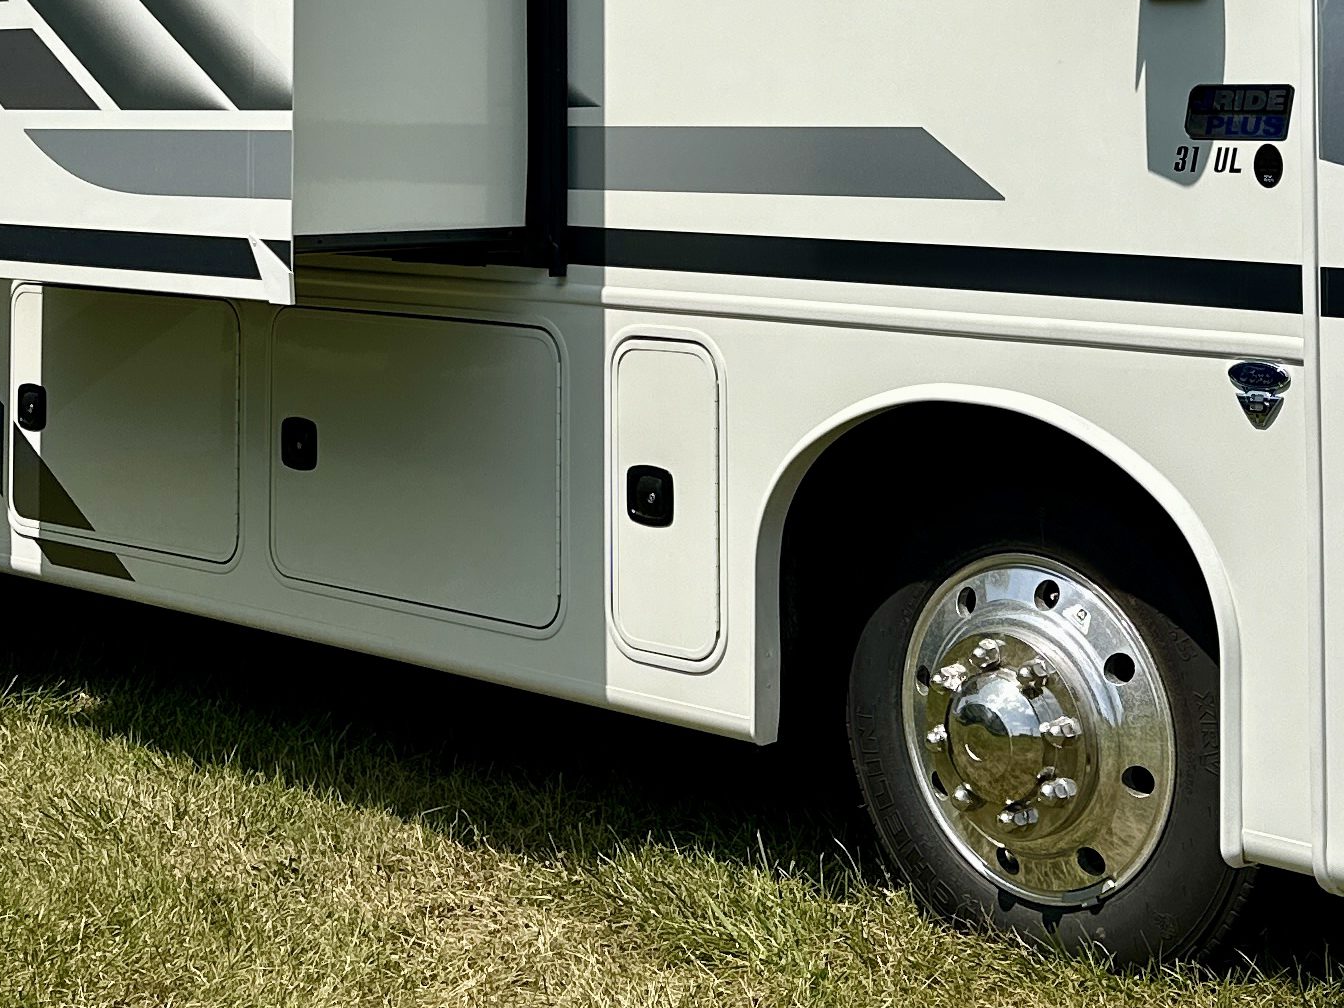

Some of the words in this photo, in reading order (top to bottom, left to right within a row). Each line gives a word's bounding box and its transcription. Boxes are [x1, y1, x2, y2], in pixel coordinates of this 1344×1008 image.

[1205, 115, 1284, 136] PLUS
[1174, 145, 1200, 173] 31
[1214, 146, 1242, 173] UL
